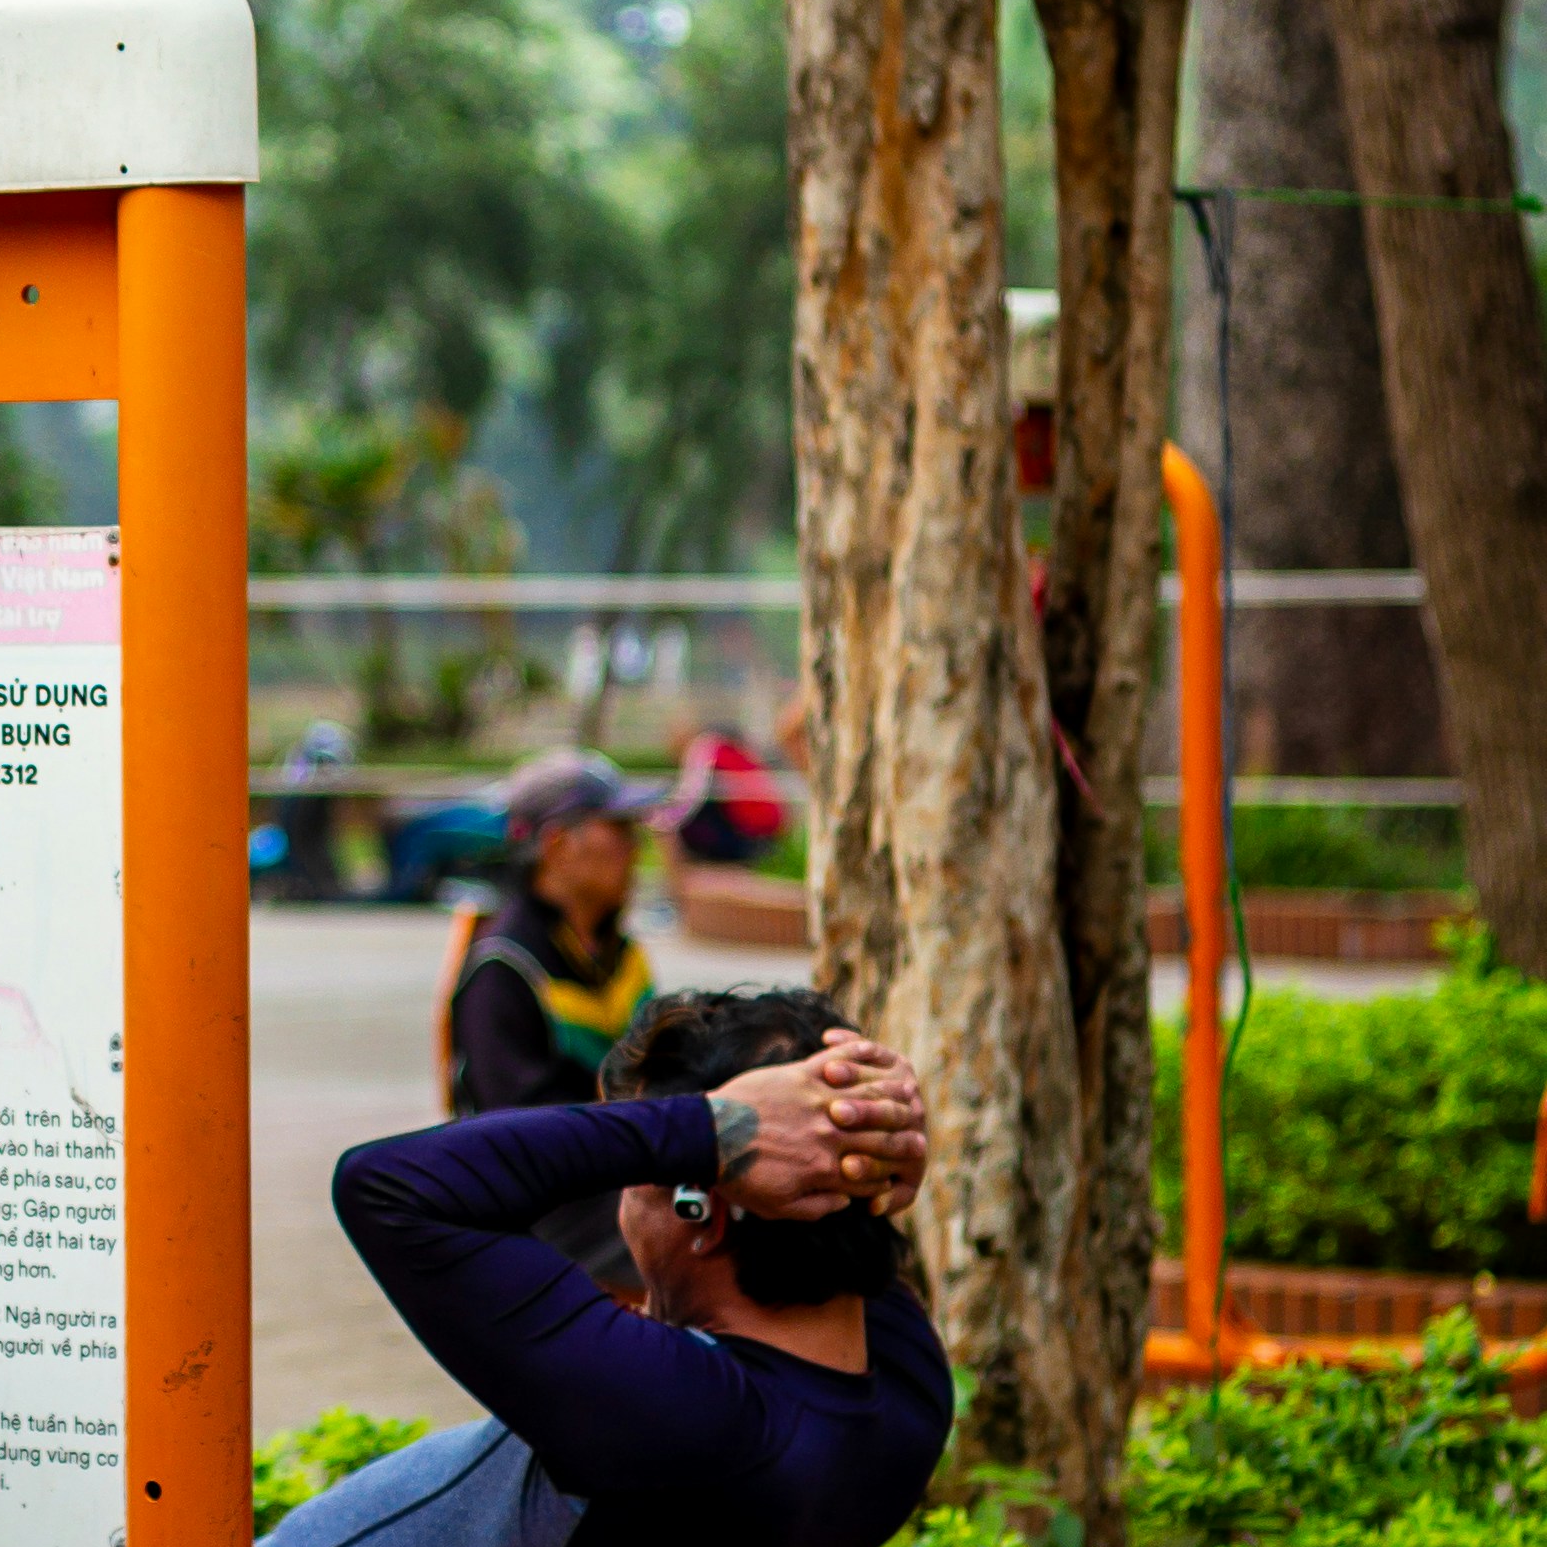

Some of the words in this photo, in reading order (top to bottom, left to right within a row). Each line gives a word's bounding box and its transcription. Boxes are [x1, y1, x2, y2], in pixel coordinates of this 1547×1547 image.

[2, 567, 46, 596] Việt
[52, 569, 106, 590] Nam
[35, 683, 108, 713] DỤNG
[1, 723, 71, 752] BỤNG
[25, 1110, 60, 1127] trên
[34, 1139, 59, 1157] hai
[65, 1140, 116, 1160] thanh
[13, 1168, 50, 1190] phía
[55, 1175, 91, 1192] sau,
[95, 1177, 116, 1190] cơ
[23, 1198, 60, 1222] Gập
[66, 1204, 115, 1224] người
[23, 1229, 51, 1252] đặt
[58, 1231, 83, 1249] hai
[89, 1234, 117, 1256] tay
[18, 1259, 56, 1279] hơn.
[6, 1305, 41, 1329] Ngả
[46, 1311, 95, 1331] người
[100, 1315, 116, 1329] ra
[51, 1338, 72, 1357] về
[80, 1340, 117, 1361] phía
[0, 1412, 21, 1434] hệ
[28, 1414, 67, 1433] tuần
[75, 1416, 117, 1436] hoàn
[47, 1447, 90, 1470] vùng
[97, 1453, 118, 1467] cơ
